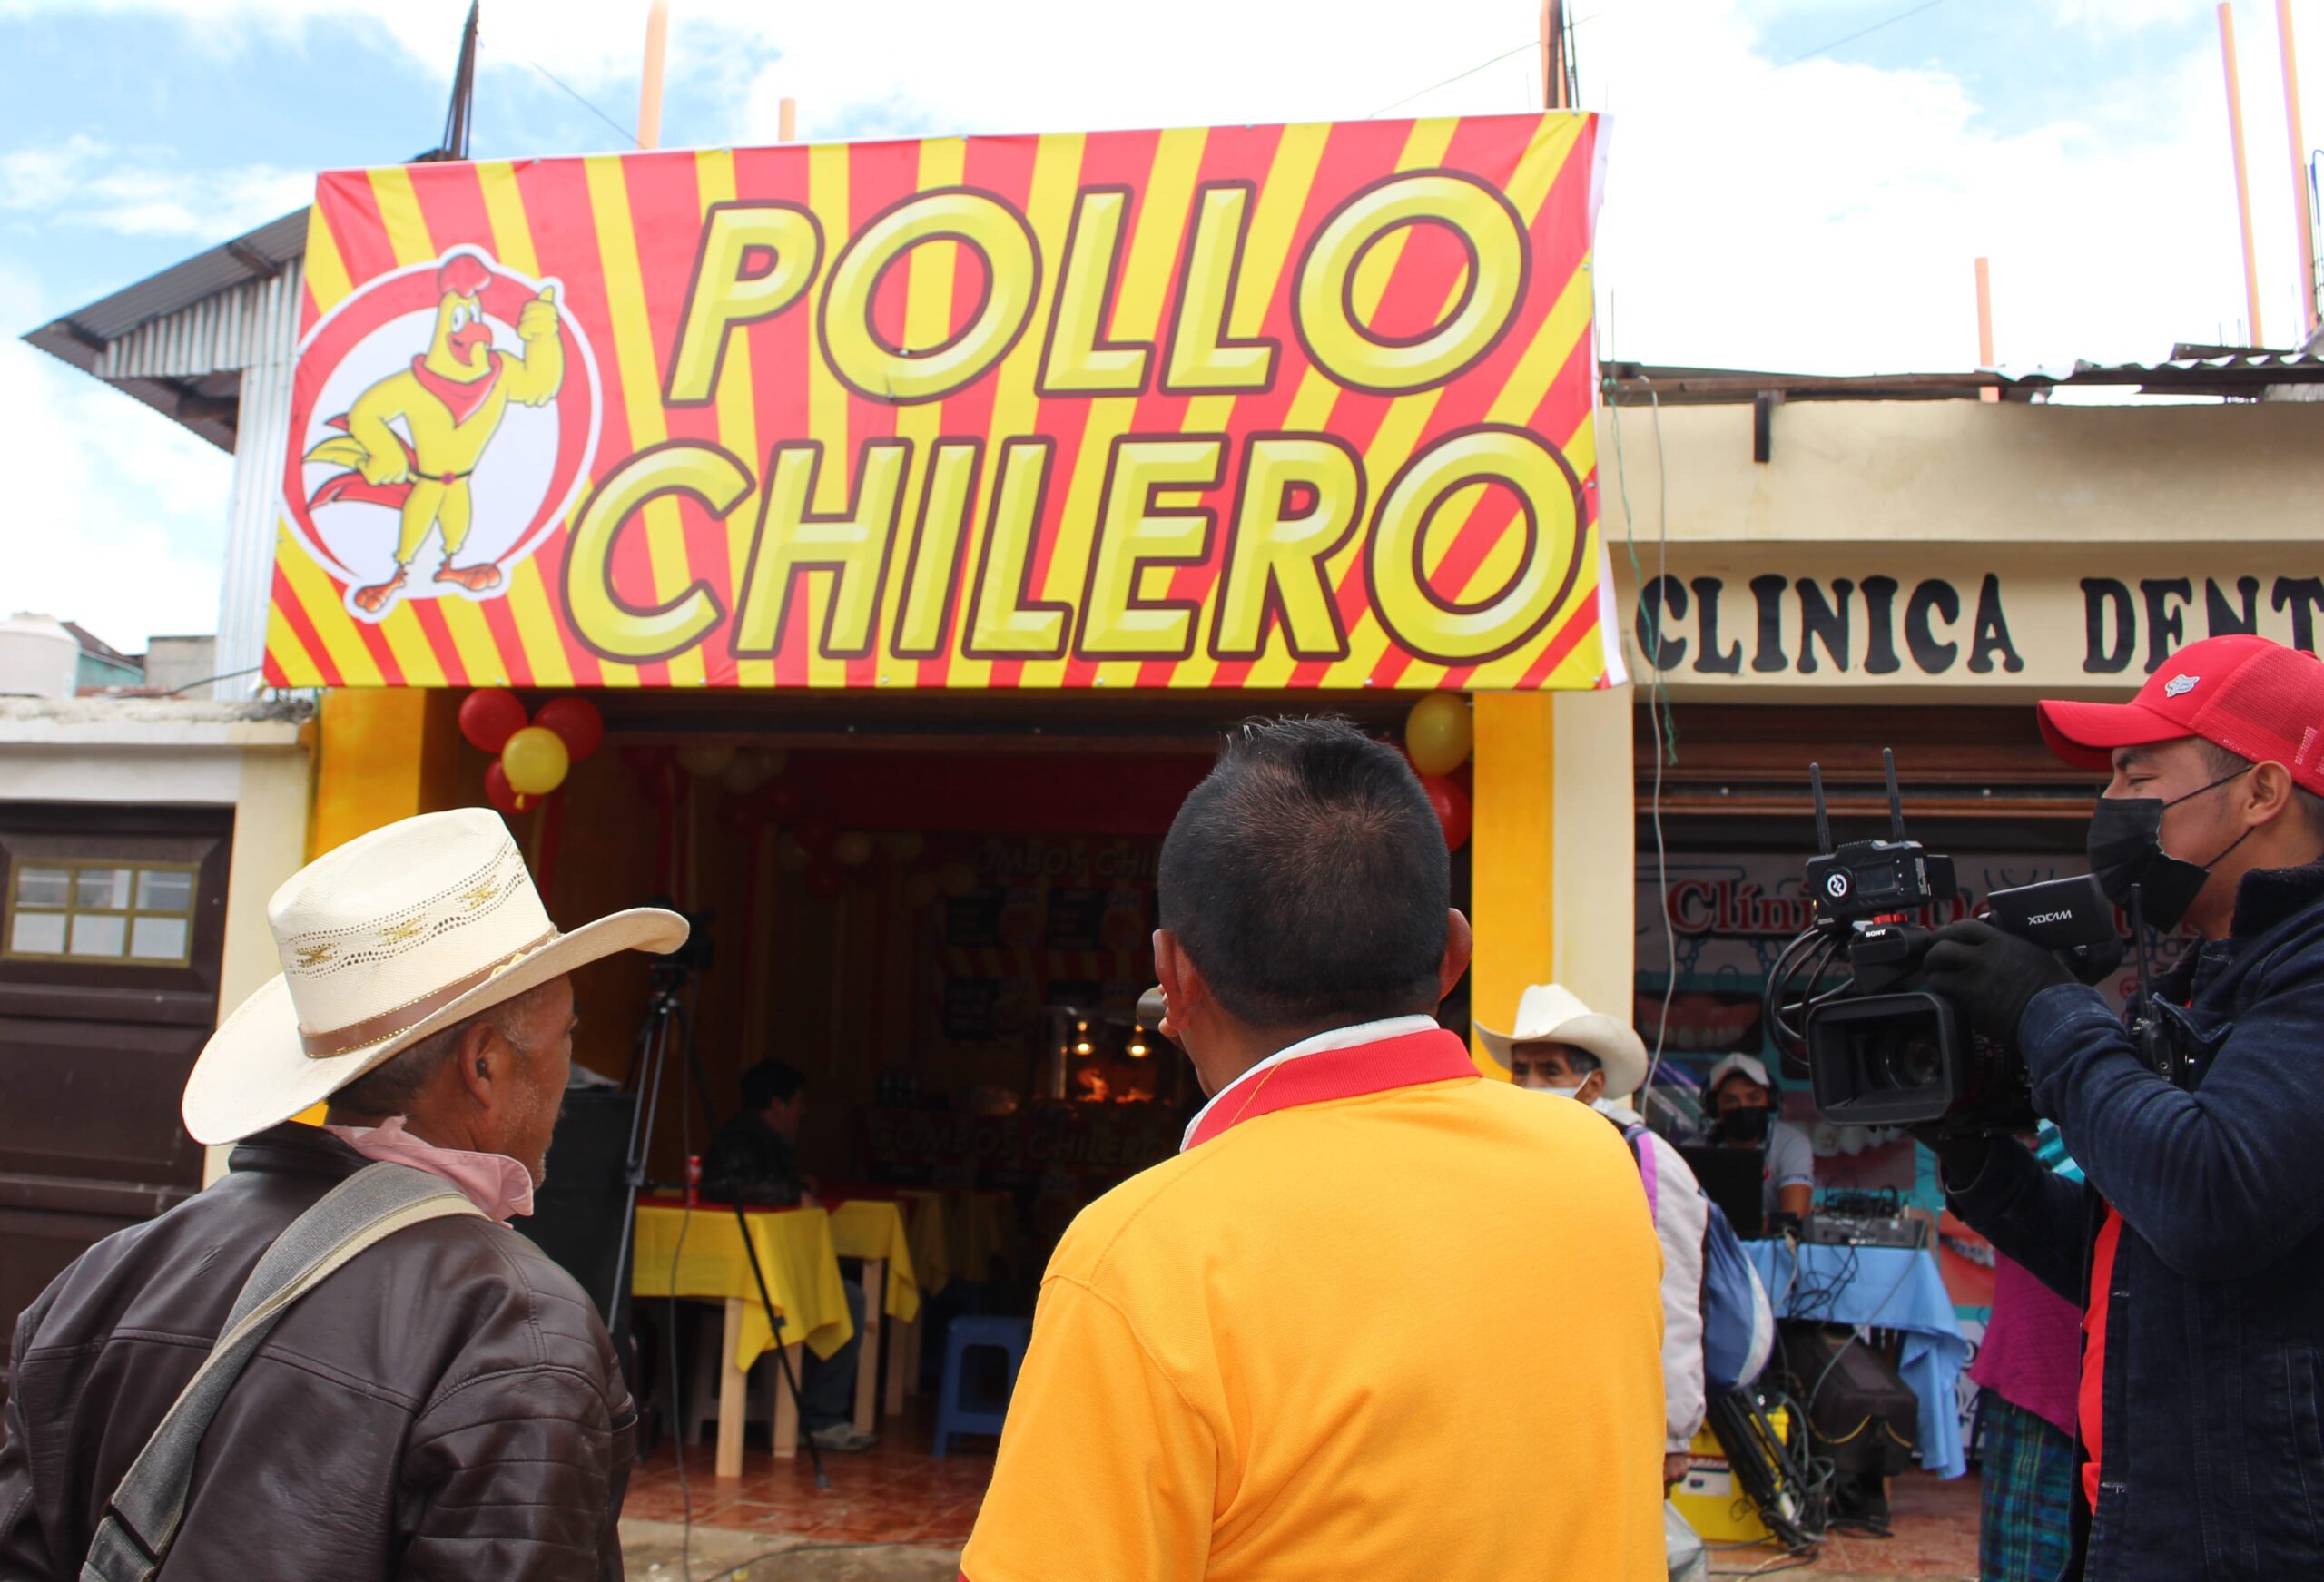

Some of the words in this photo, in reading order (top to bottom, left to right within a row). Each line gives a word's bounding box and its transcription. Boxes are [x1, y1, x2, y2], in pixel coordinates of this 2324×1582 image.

[663, 170, 1531, 406] POLLO
[561, 425, 1585, 664] CHILERO
[1636, 574, 2024, 673] CLINICA
[970, 845, 1086, 878] OMBOS
[1667, 879, 1812, 931] Clíni
[2027, 909, 2073, 926] XDCAM
[1866, 929, 1886, 938] SONY
